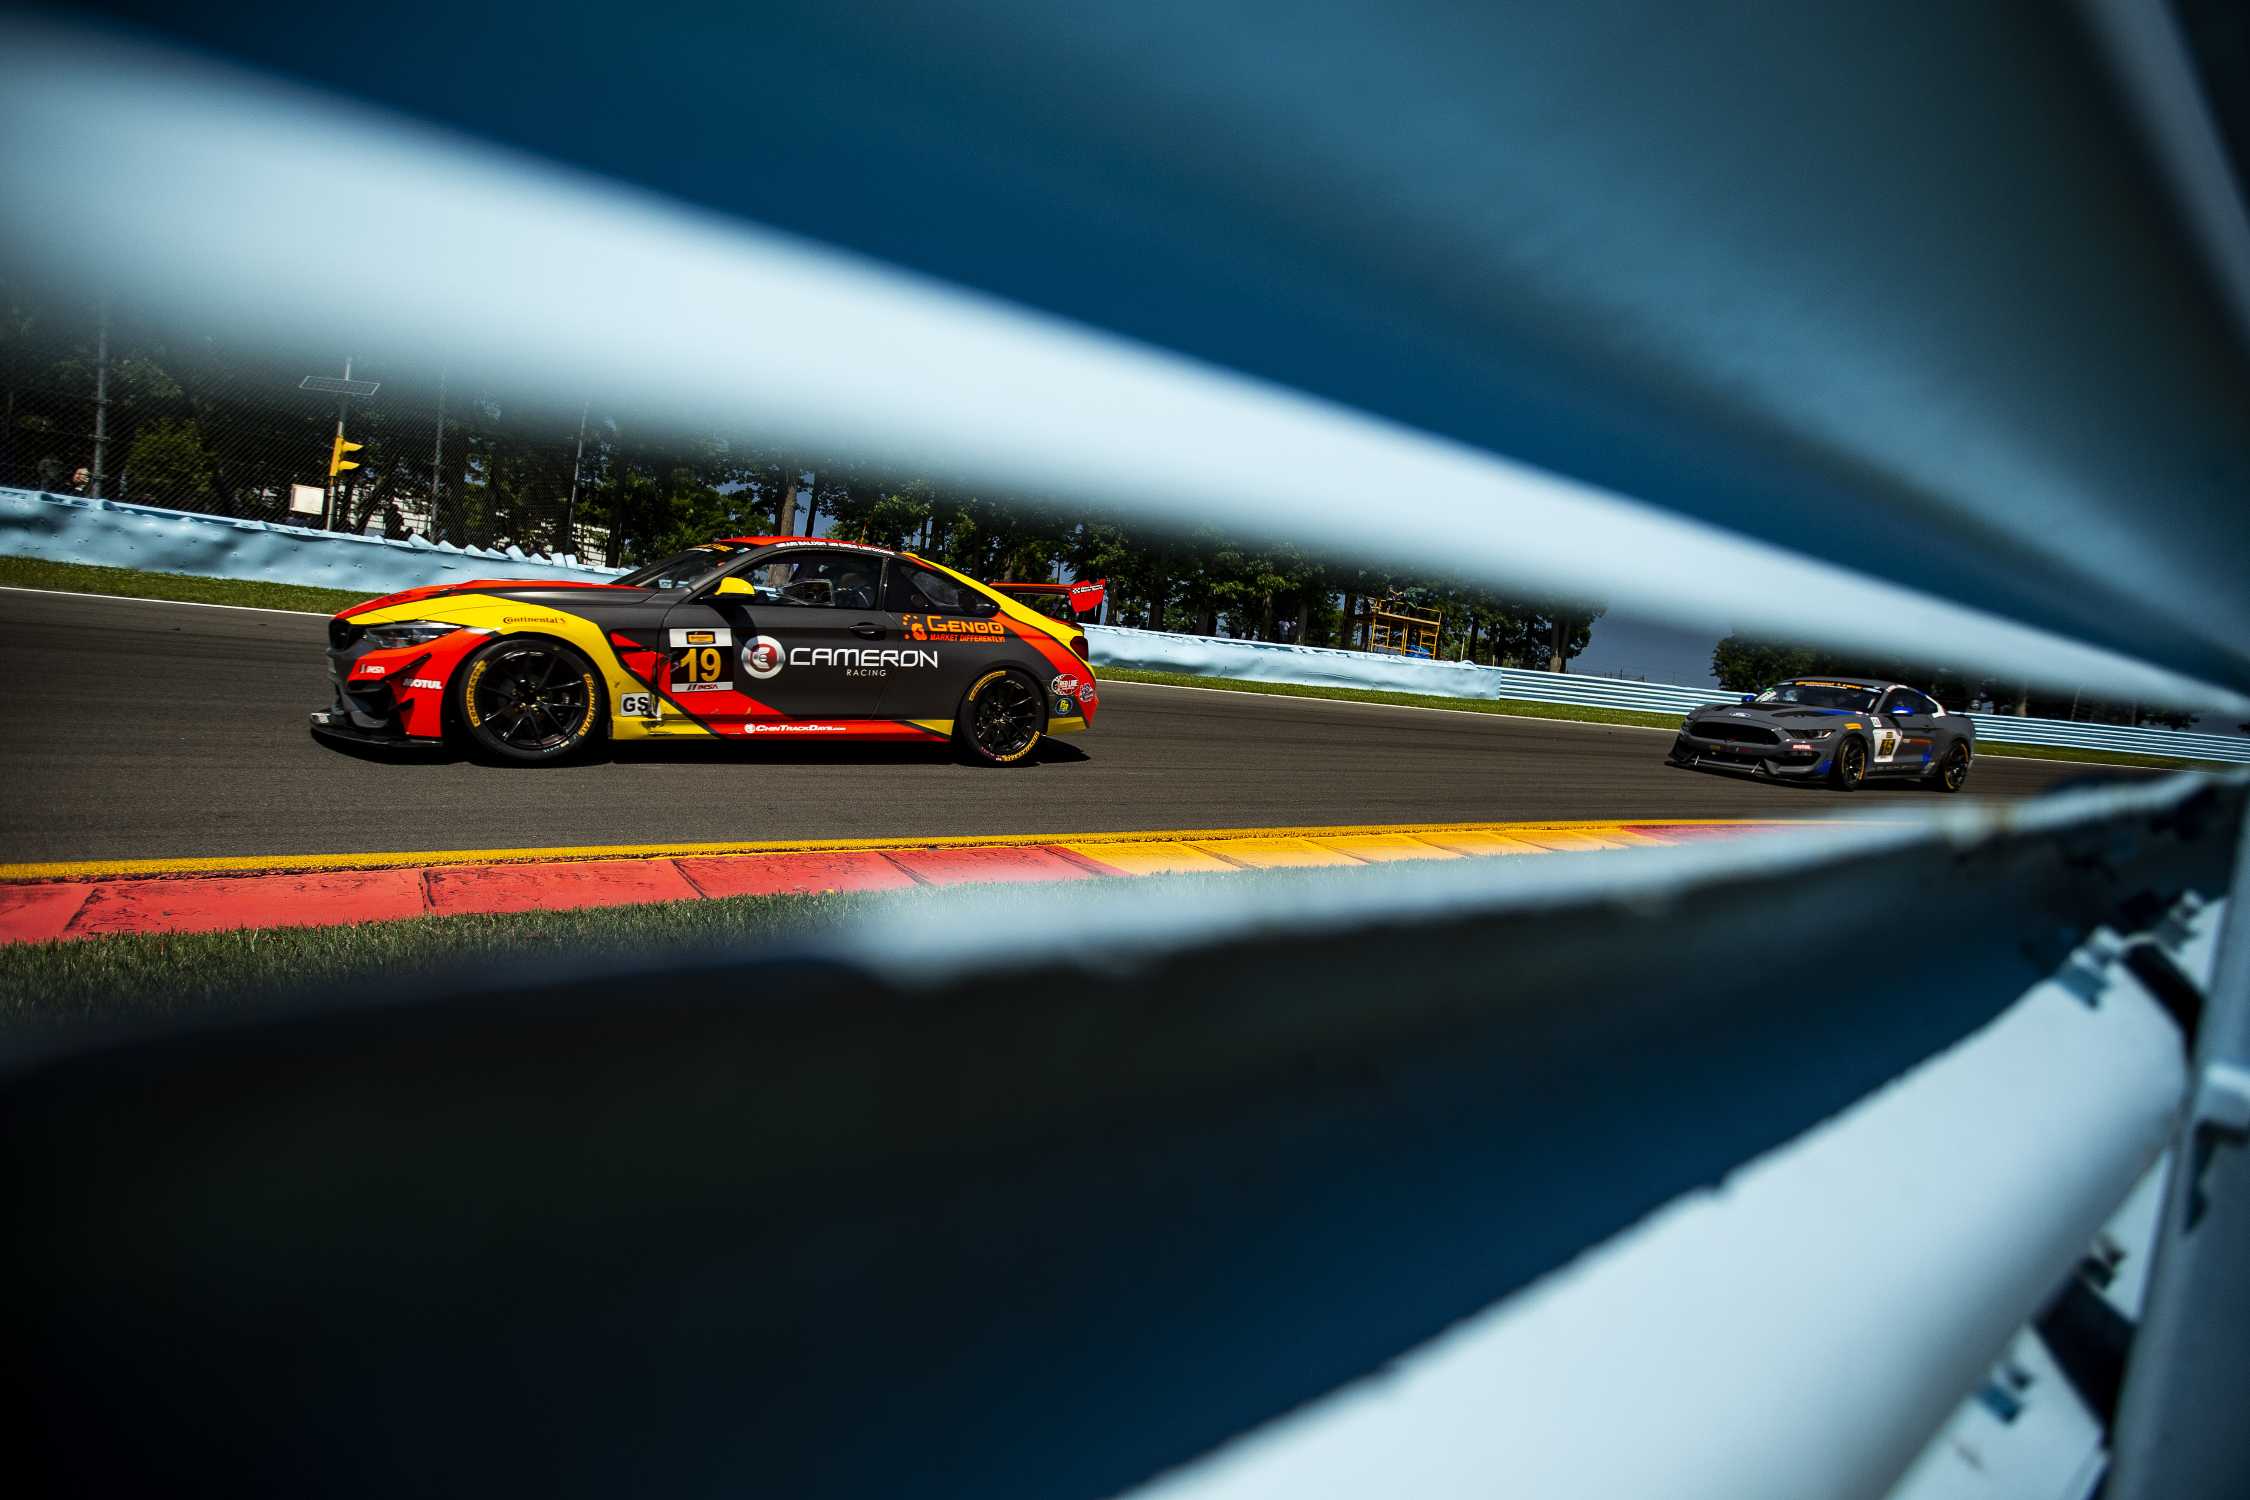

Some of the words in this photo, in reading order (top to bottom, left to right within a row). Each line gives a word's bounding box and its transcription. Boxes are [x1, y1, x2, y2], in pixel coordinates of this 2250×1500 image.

[503, 616, 558, 624] Continental
[680, 648, 721, 682] 19
[789, 647, 939, 669] CAMERON
[846, 669, 887, 677] RACING
[402, 678, 443, 690] MOTUL
[623, 696, 648, 712] GS
